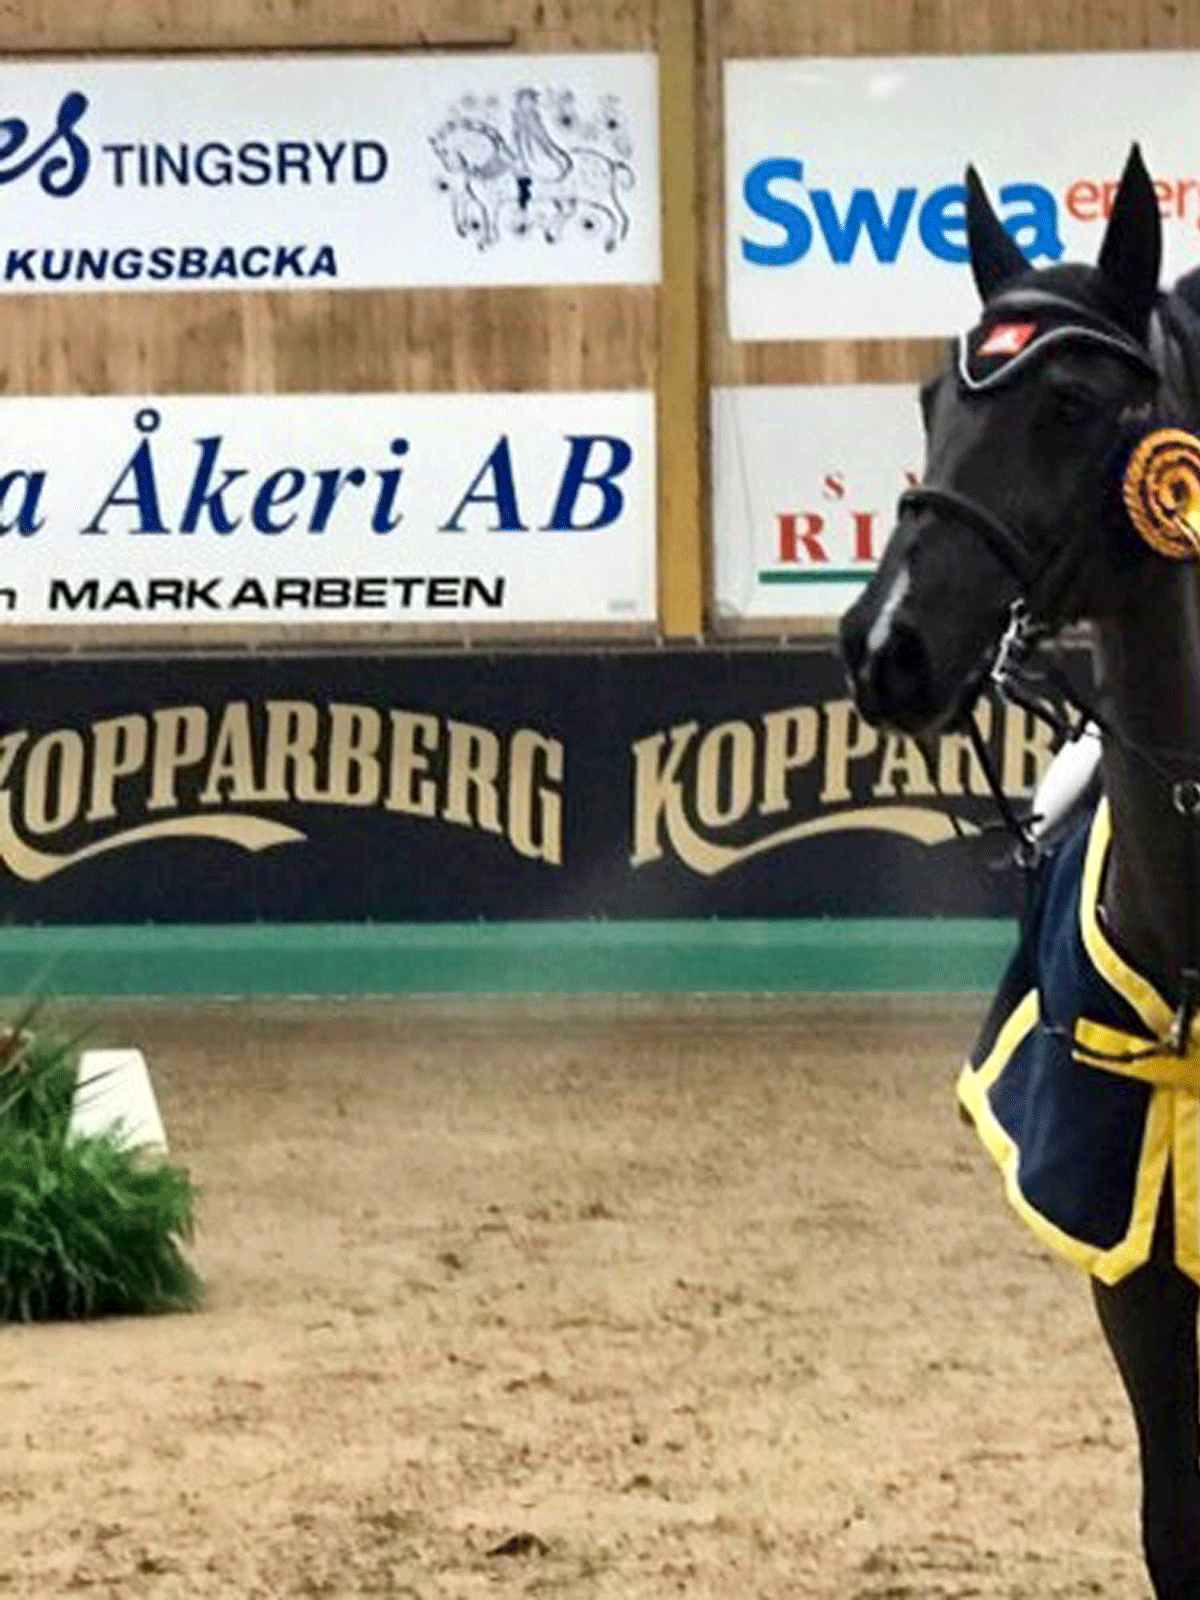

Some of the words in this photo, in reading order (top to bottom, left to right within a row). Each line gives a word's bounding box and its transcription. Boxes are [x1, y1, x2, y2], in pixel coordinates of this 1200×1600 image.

[102, 141, 388, 187] TINGSRYD
[741, 157, 1065, 267] Swea
[4, 246, 337, 281] KUNGSBACKA
[80, 408, 409, 535] Åkeri
[439, 434, 632, 533] AB
[49, 577, 505, 610] MARKARBETEN
